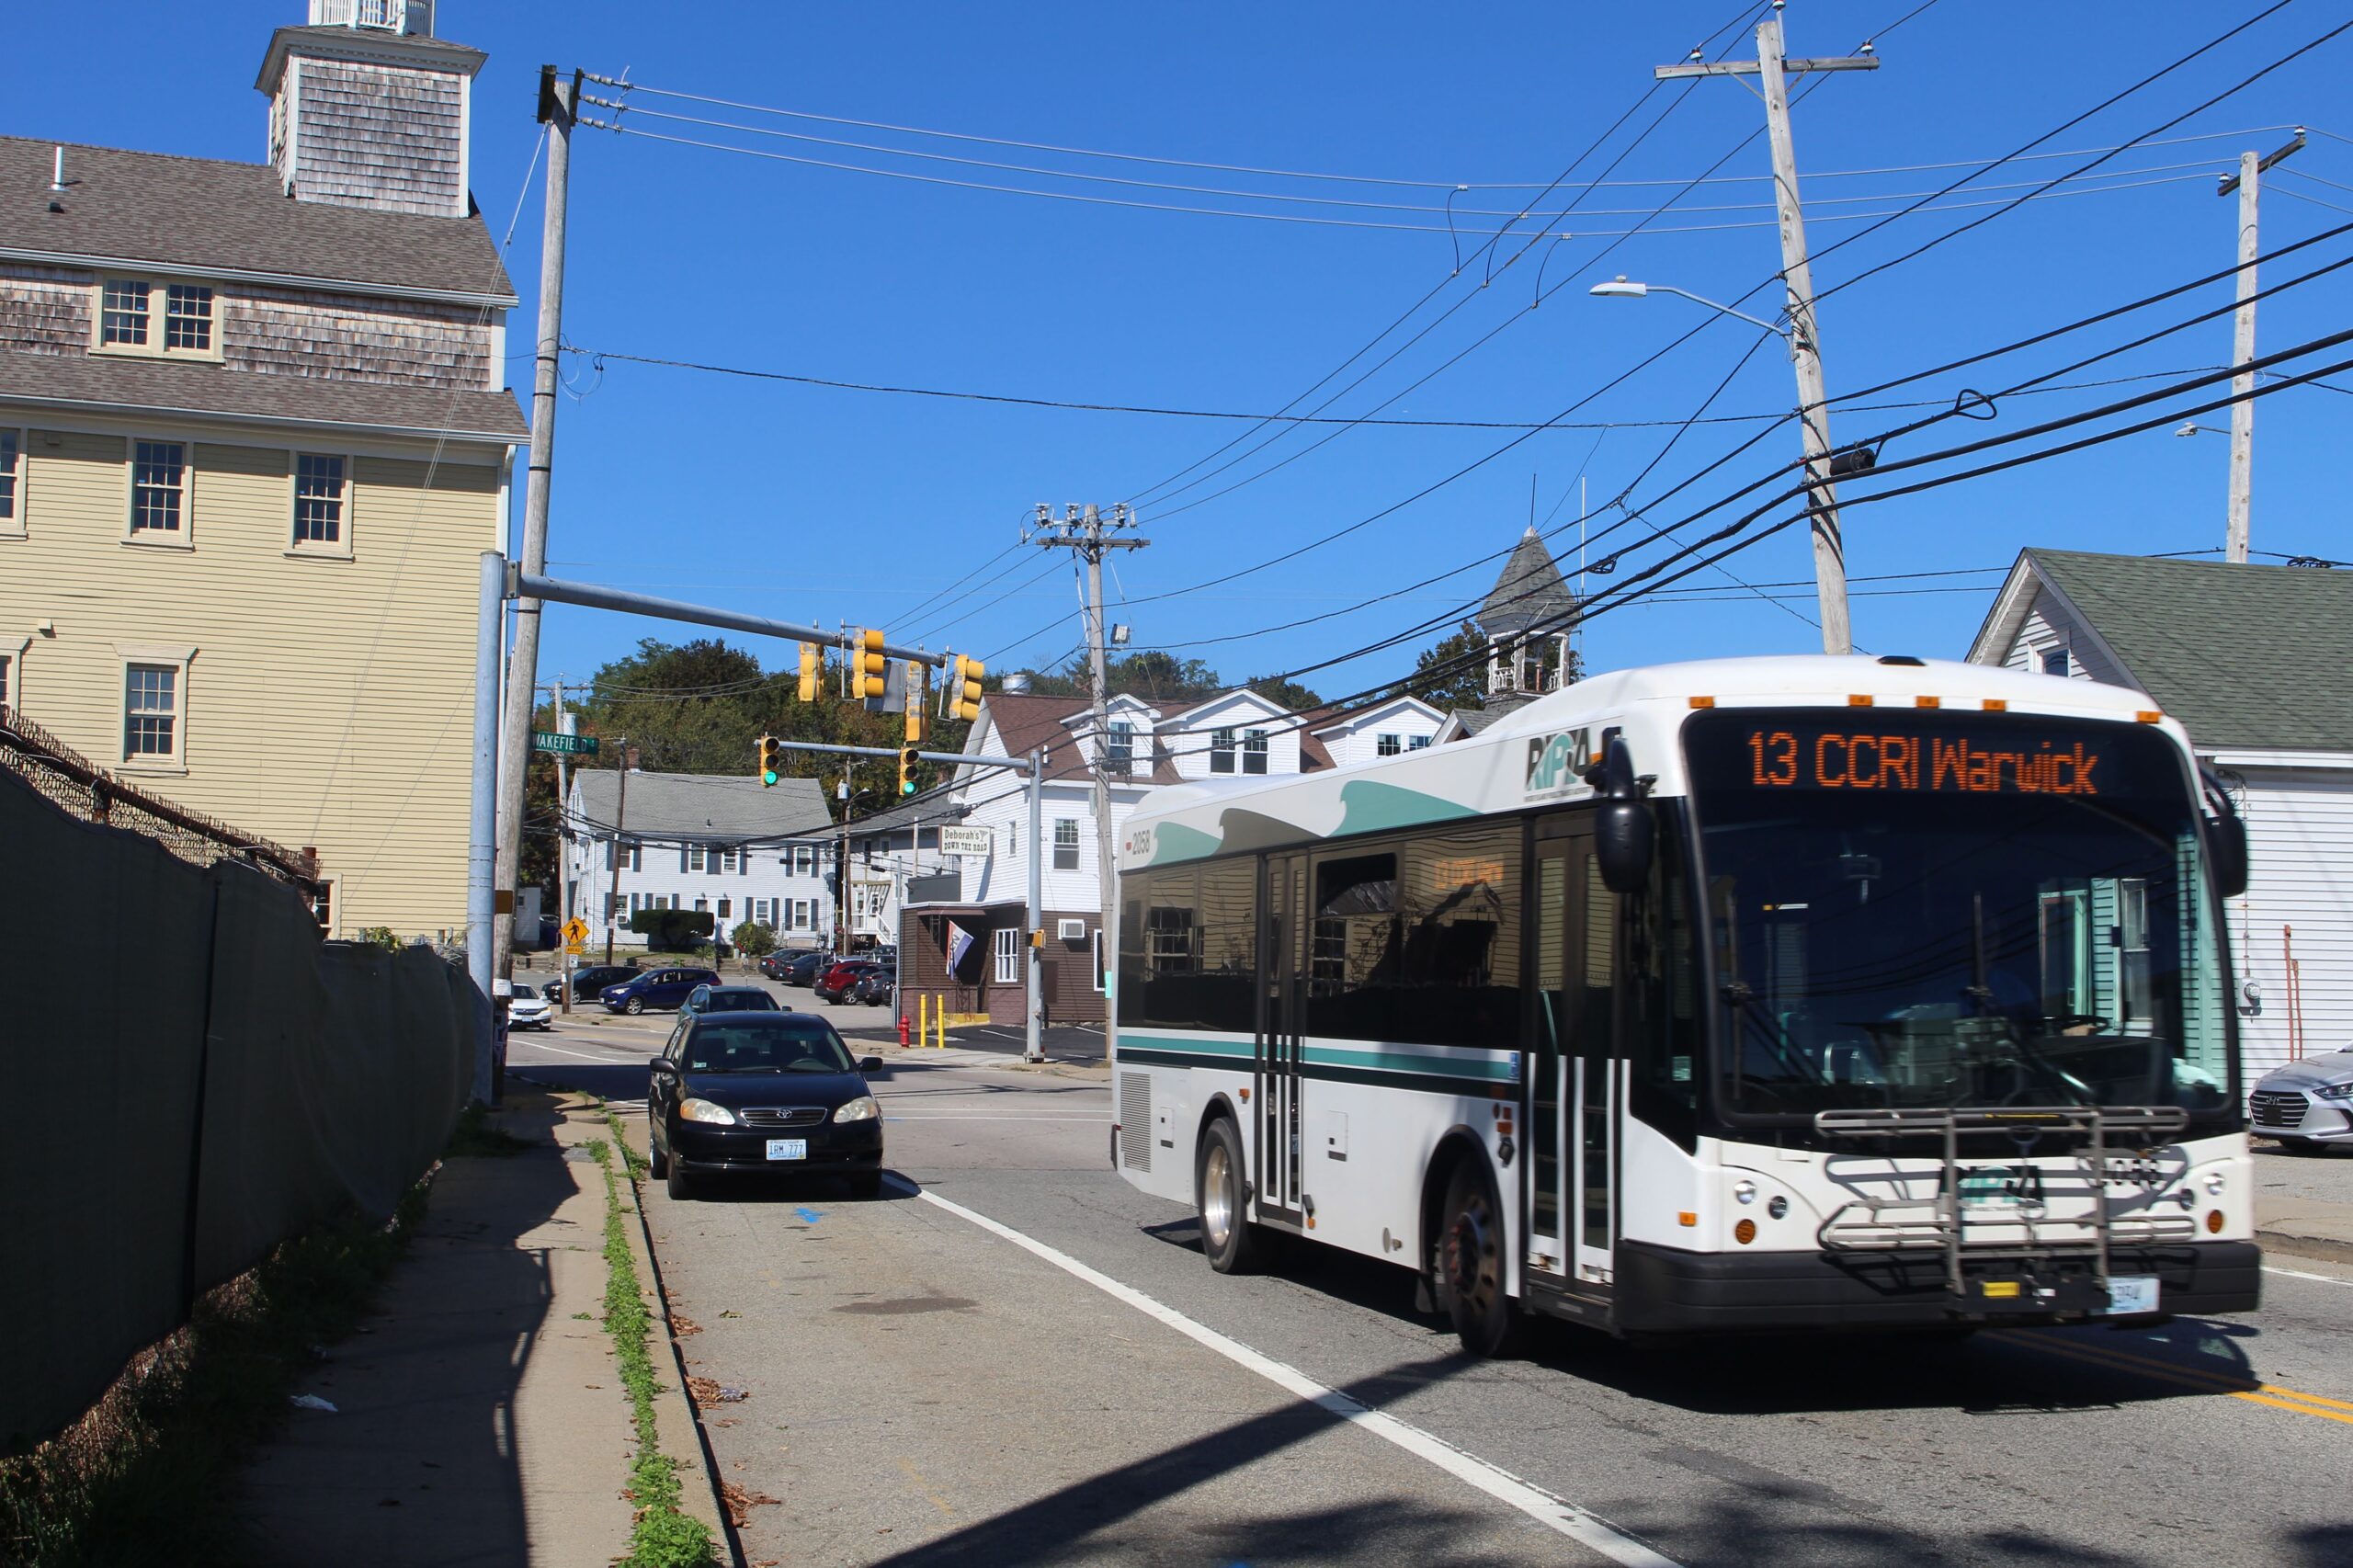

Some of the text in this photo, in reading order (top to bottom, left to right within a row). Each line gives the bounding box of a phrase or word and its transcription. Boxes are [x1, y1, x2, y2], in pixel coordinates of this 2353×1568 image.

[531, 733, 586, 751] WAKEFIELD
[1748, 732, 2097, 794] 13 CCRI Warwick
[945, 829, 980, 840] Deborah's
[944, 841, 987, 852] DOWN THE ROAD
[1132, 829, 1150, 855] 2058
[789, 1144, 803, 1154] 777
